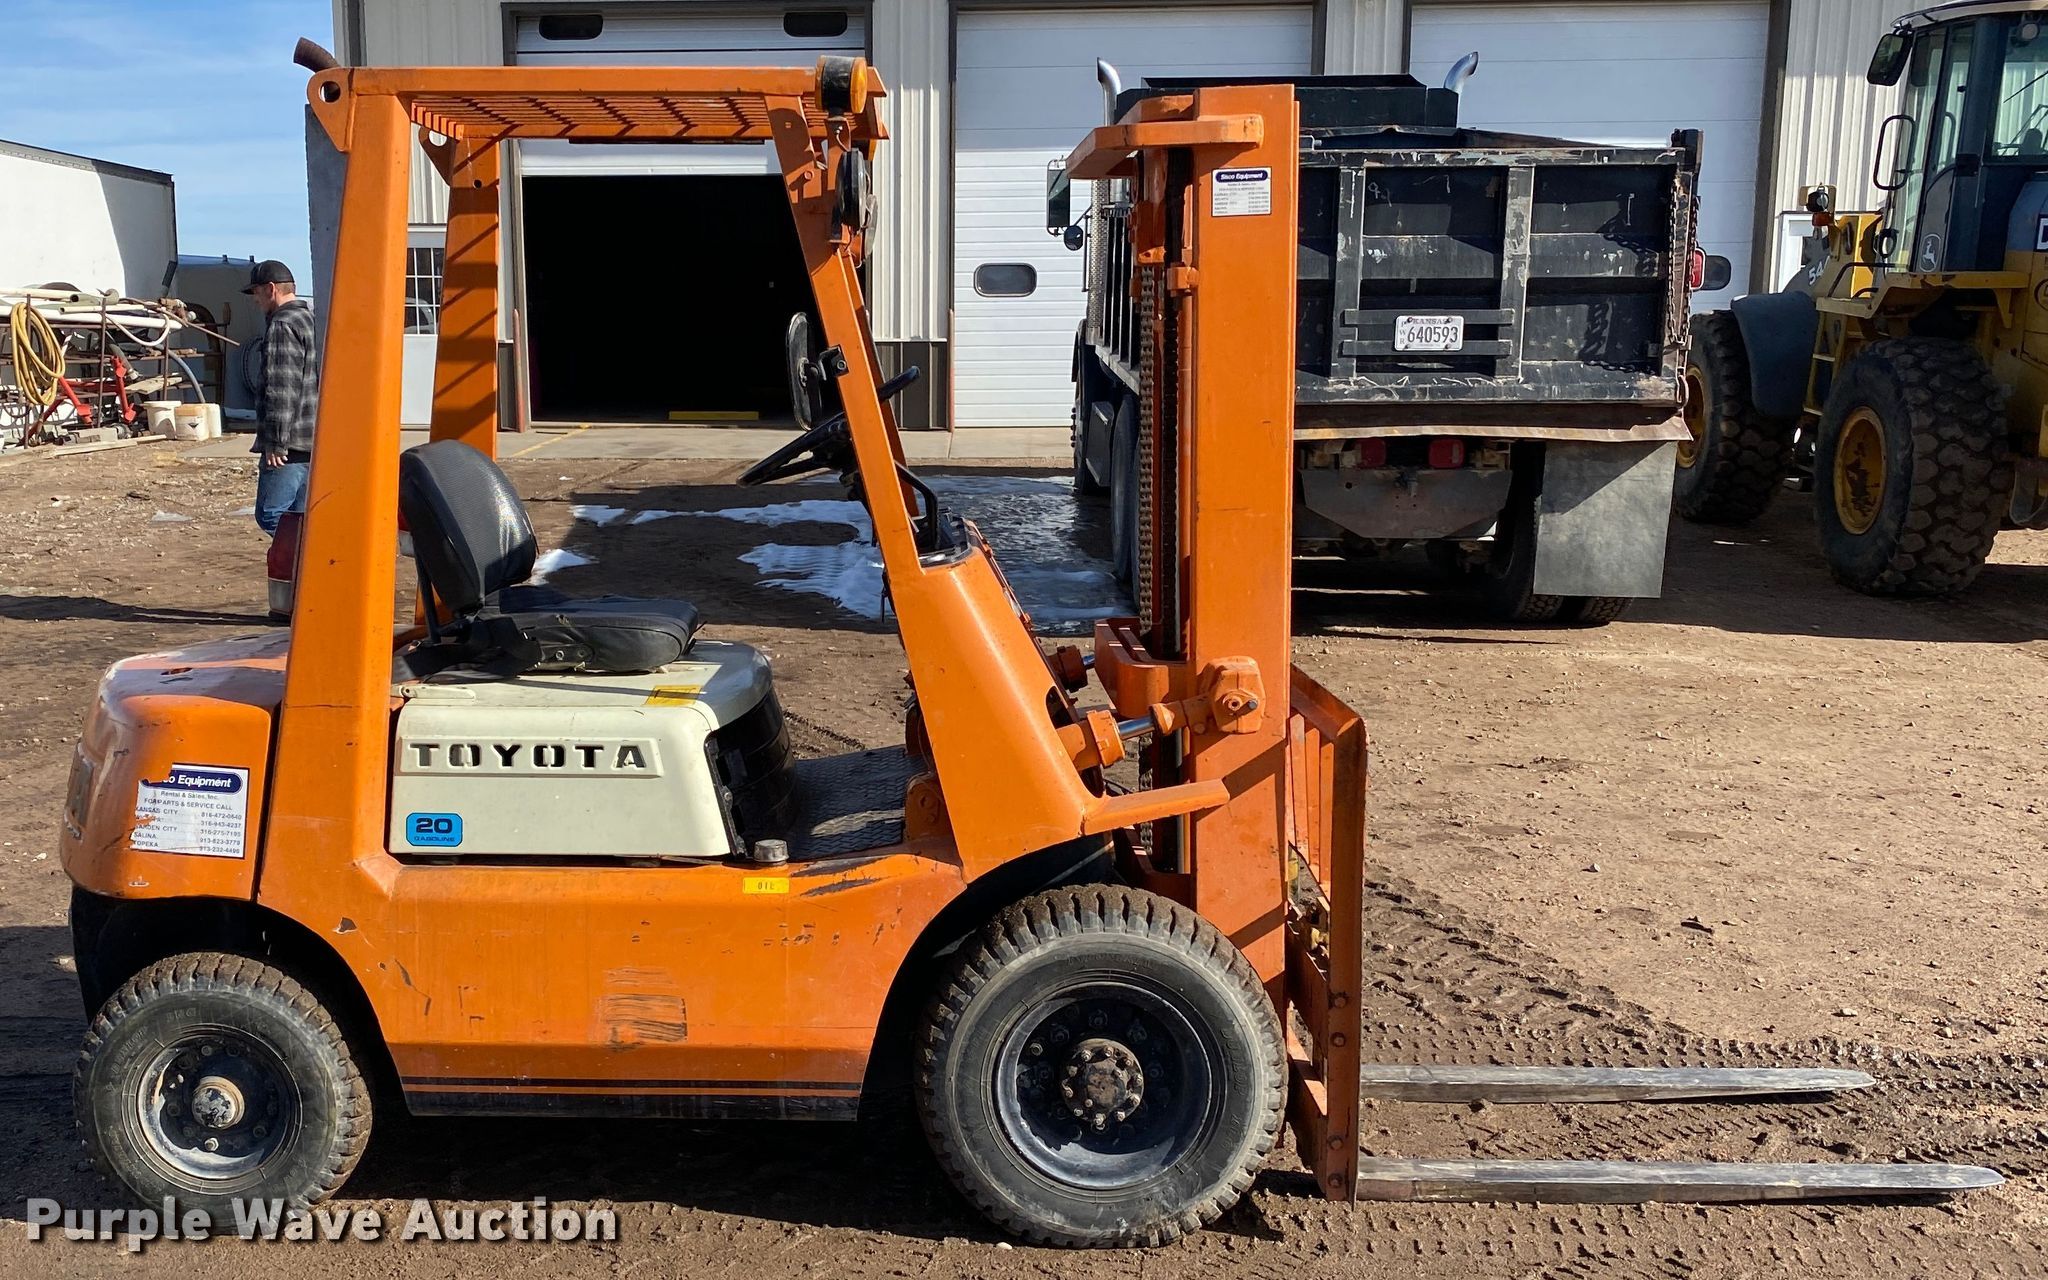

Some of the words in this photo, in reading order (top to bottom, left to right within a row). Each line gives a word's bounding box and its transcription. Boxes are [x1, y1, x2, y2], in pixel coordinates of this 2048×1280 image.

[1235, 172, 1263, 180] Equipment
[1407, 326, 1459, 343] 640593
[410, 743, 647, 768] TOYOTA
[177, 774, 232, 788] Equipment
[186, 801, 214, 810] SERVICE
[416, 817, 452, 834] 20
